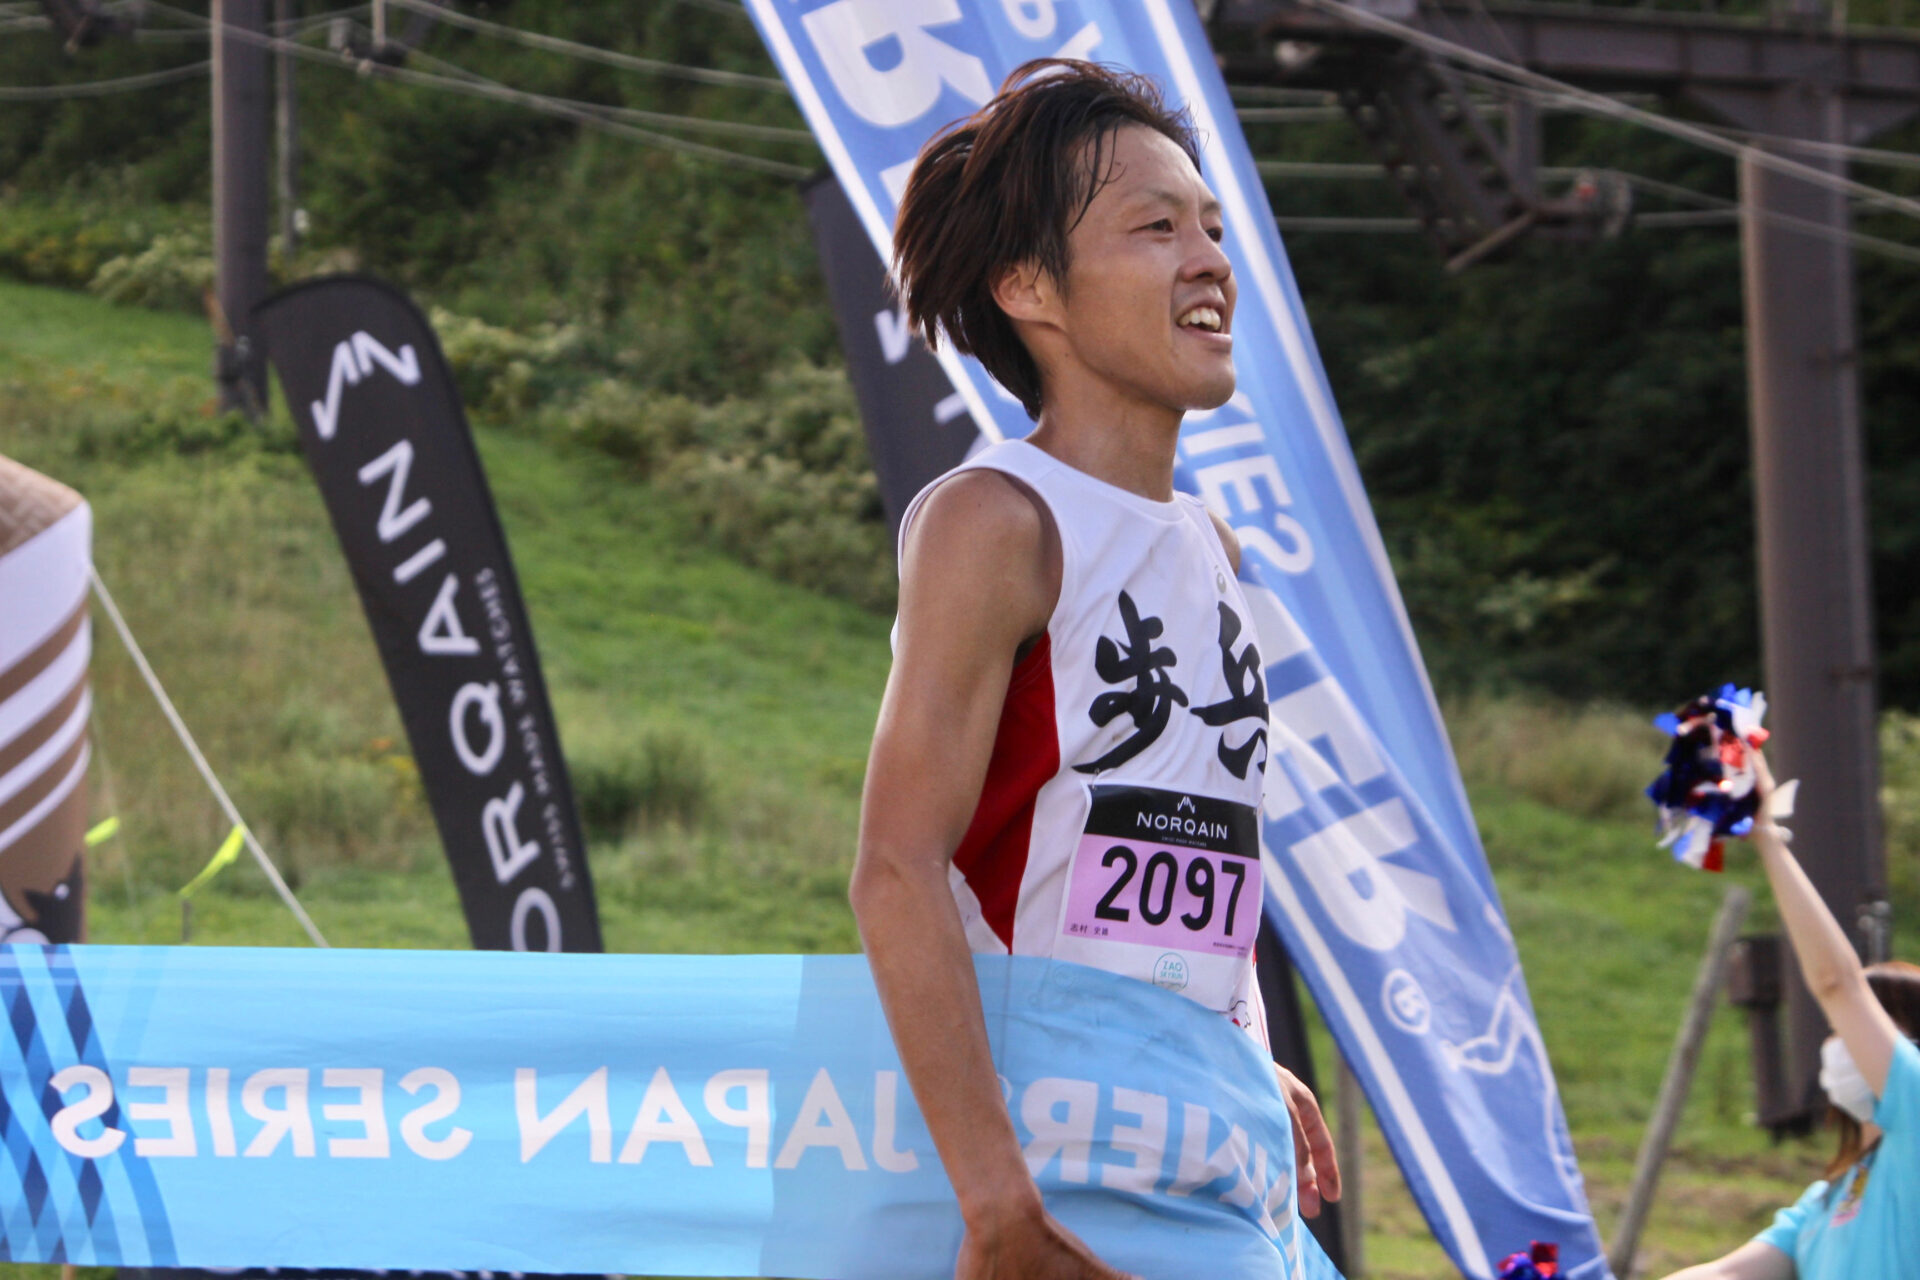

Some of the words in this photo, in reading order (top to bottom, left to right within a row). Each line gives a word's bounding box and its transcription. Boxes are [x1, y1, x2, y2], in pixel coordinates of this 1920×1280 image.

[358, 438, 562, 953] ORQAIN
[1136, 811, 1228, 840] NORQAIN
[1094, 845, 1246, 937] 2097
[1163, 960, 1183, 972] ZAO
